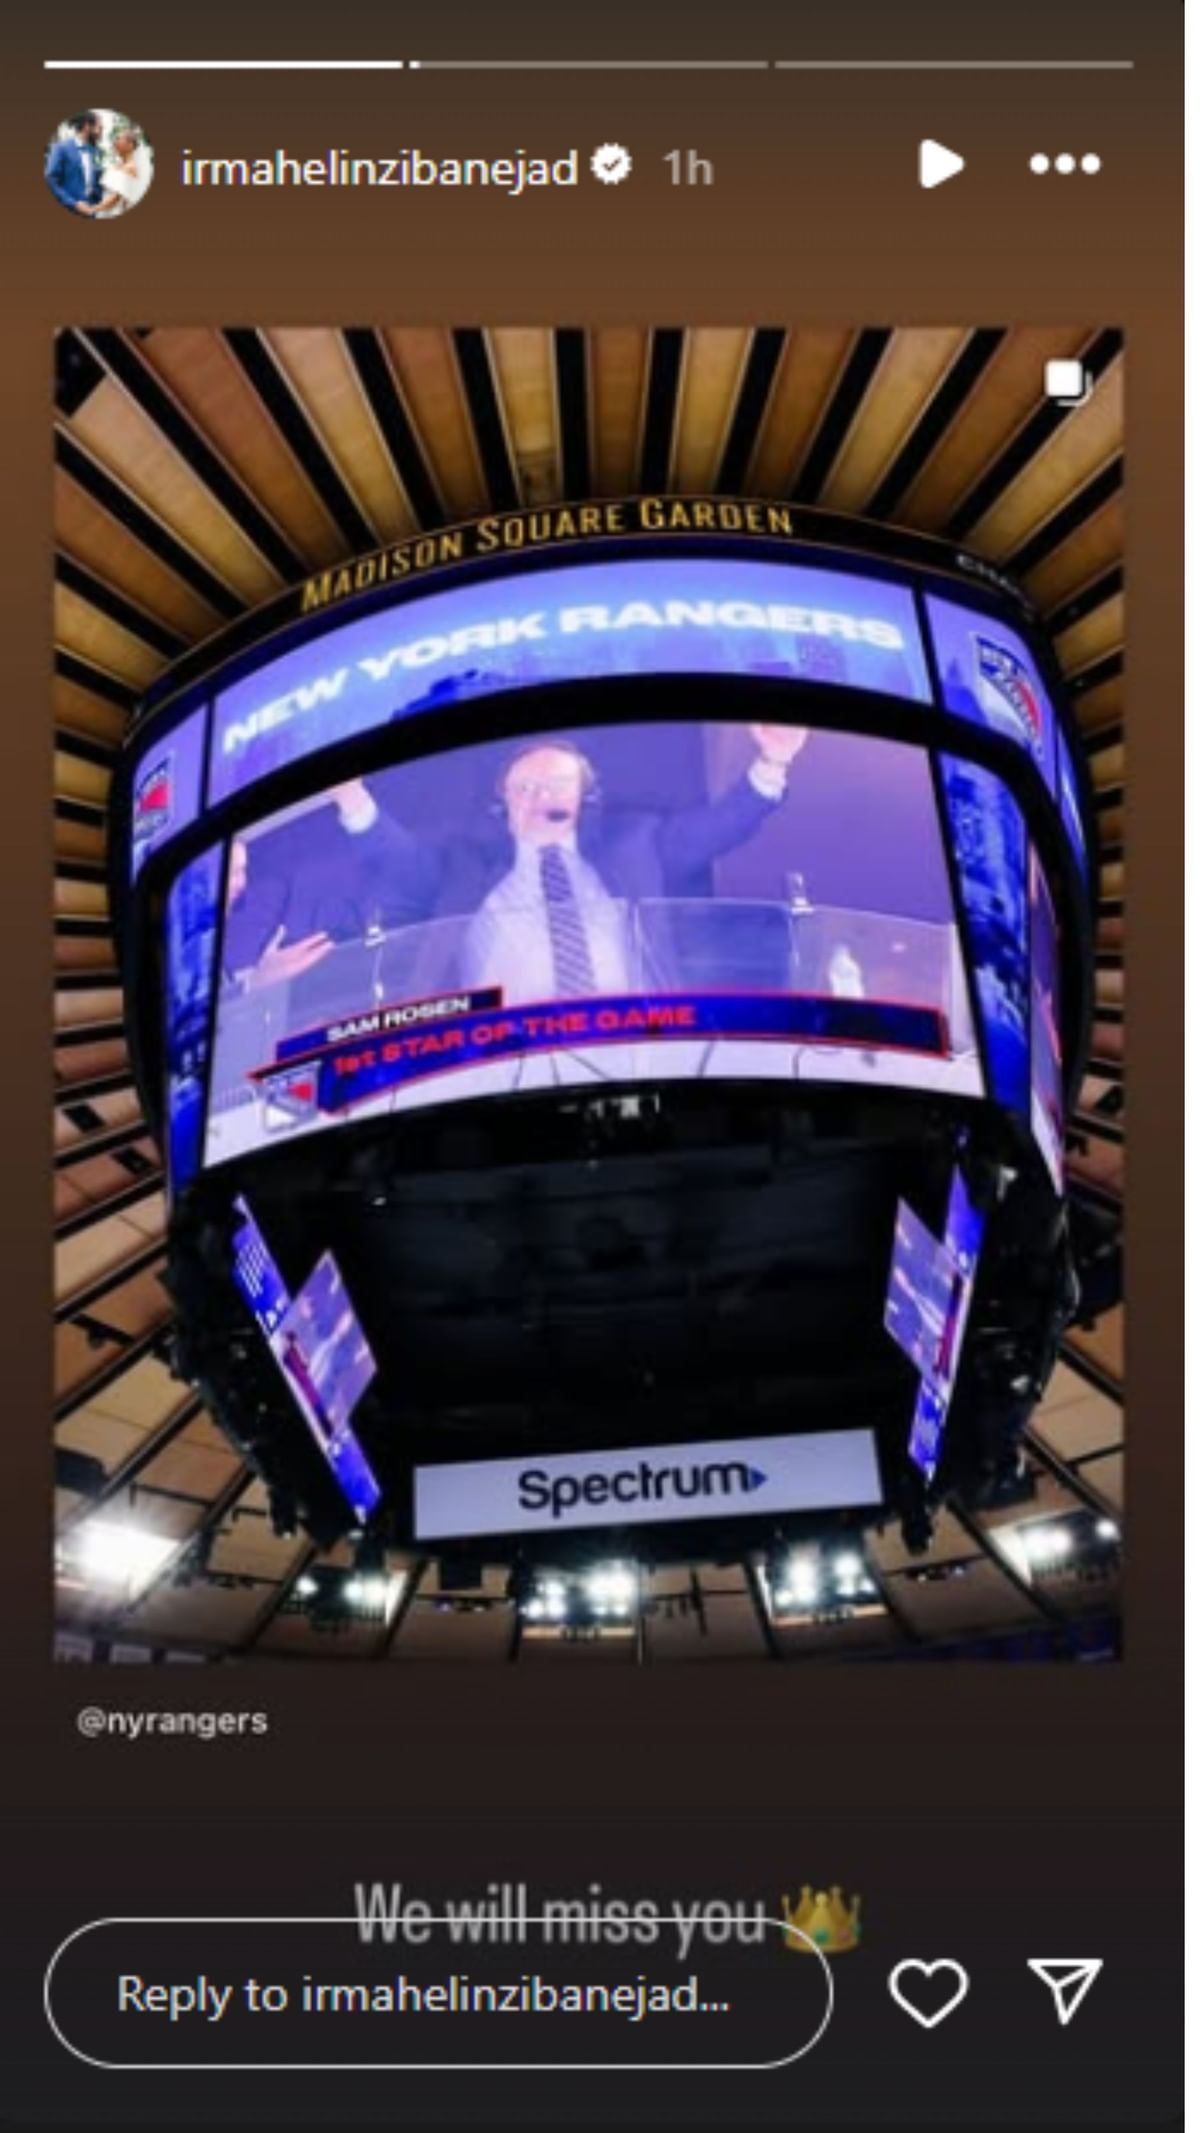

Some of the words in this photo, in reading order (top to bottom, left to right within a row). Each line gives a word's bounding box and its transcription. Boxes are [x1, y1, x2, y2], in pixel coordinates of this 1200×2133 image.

[302, 532, 462, 610] MADISON
[477, 507, 624, 550] SQUARE
[641, 501, 792, 534] GARDEN
[224, 669, 348, 752] NEW
[359, 612, 544, 680] YORK
[561, 601, 903, 648] RANGERS
[327, 1015, 381, 1042] SAM
[384, 998, 470, 1028] ROSEN
[333, 1054, 375, 1076] 1st
[383, 1033, 464, 1060] STAR
[471, 1023, 511, 1044] OF
[521, 1014, 586, 1035] THE
[597, 1004, 696, 1029] GAME
[518, 1461, 752, 1518] Spectrum
